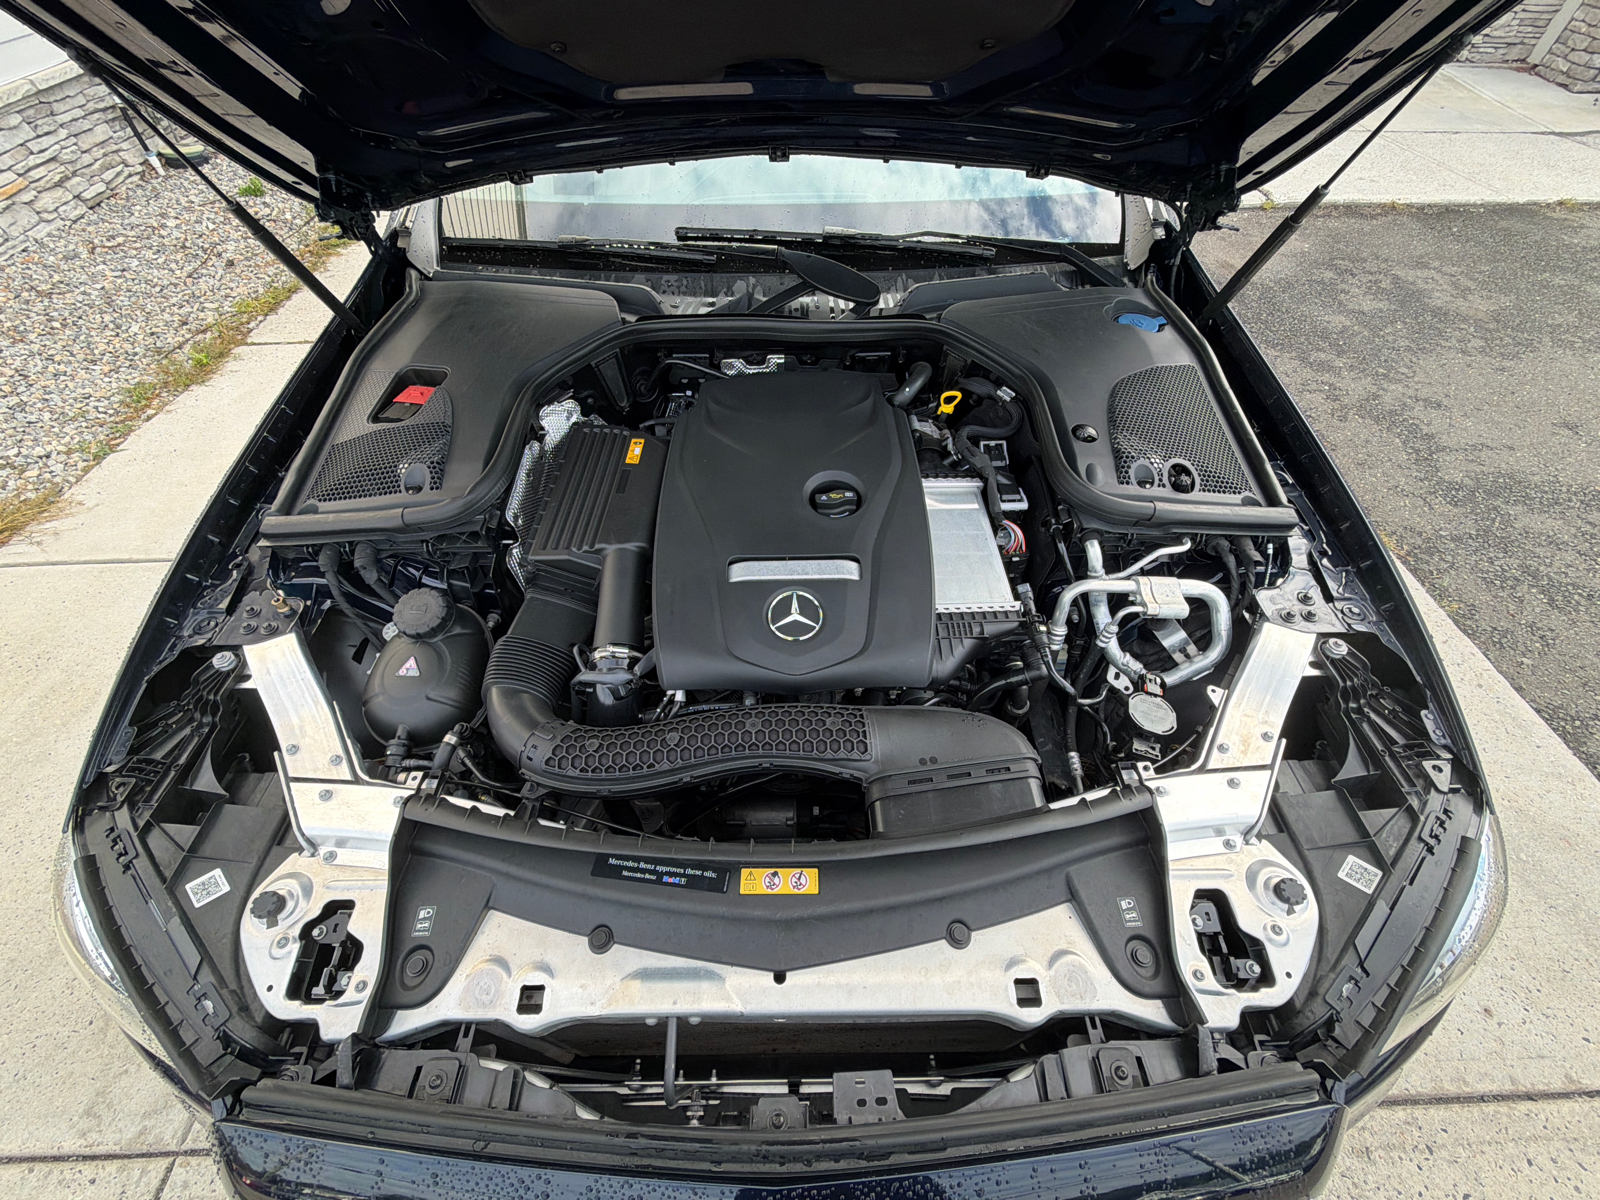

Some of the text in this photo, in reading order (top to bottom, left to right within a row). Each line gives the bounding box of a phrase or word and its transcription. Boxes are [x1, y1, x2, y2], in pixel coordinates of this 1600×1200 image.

[608, 858, 655, 870] Mercedes-Benz
[656, 865, 684, 873] approves
[622, 870, 657, 880] Mercedes-Benz
[662, 876, 680, 884] Mobil
